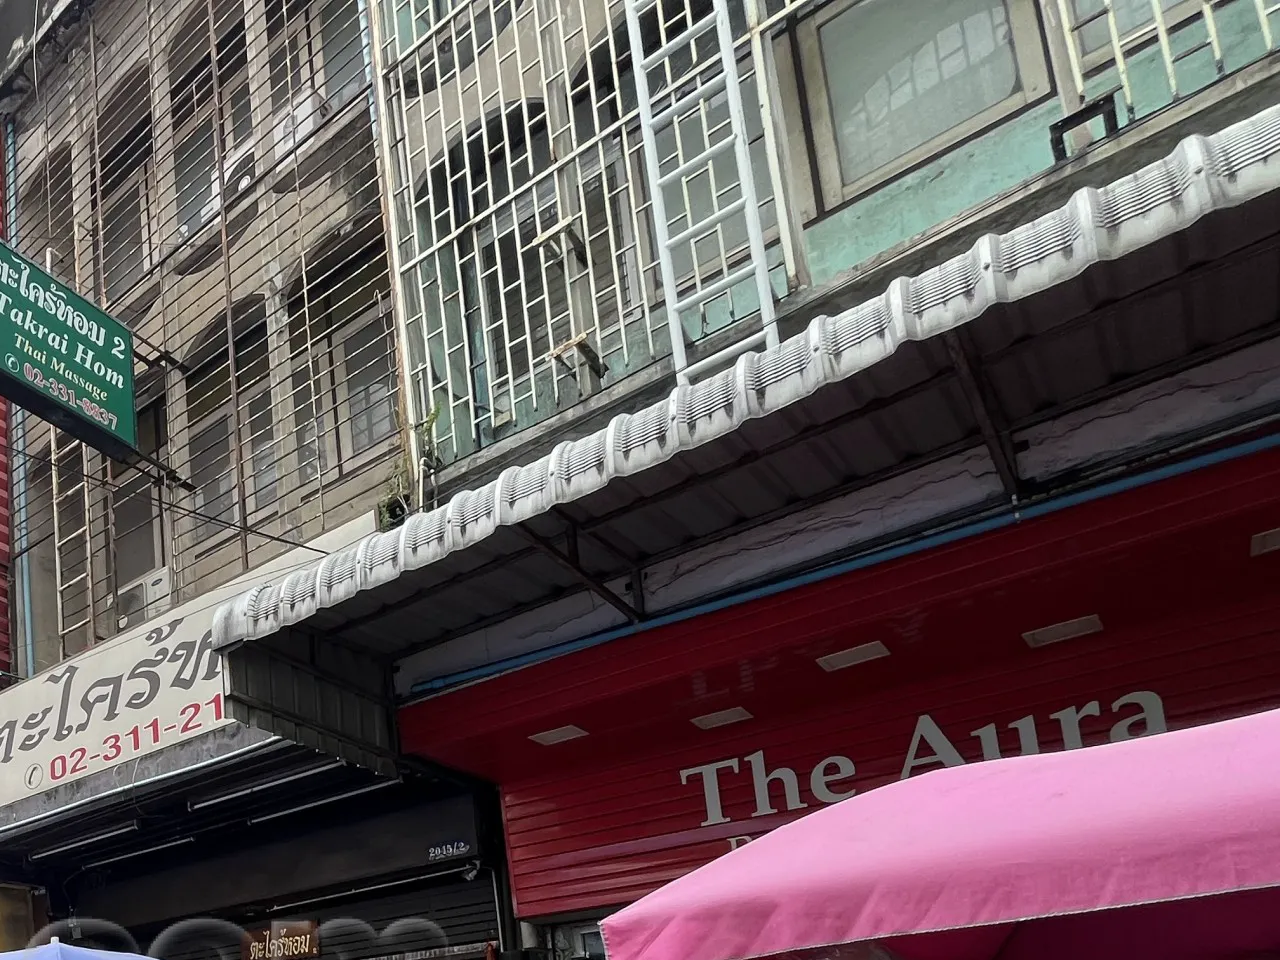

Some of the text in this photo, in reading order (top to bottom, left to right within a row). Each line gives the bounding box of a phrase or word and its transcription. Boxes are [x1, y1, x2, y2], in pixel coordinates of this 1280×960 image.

[13, 332, 108, 401] Thai Massage
[73, 340, 124, 389] Hom
[111, 336, 126, 360] 2
[678, 689, 1169, 828] The Aura
